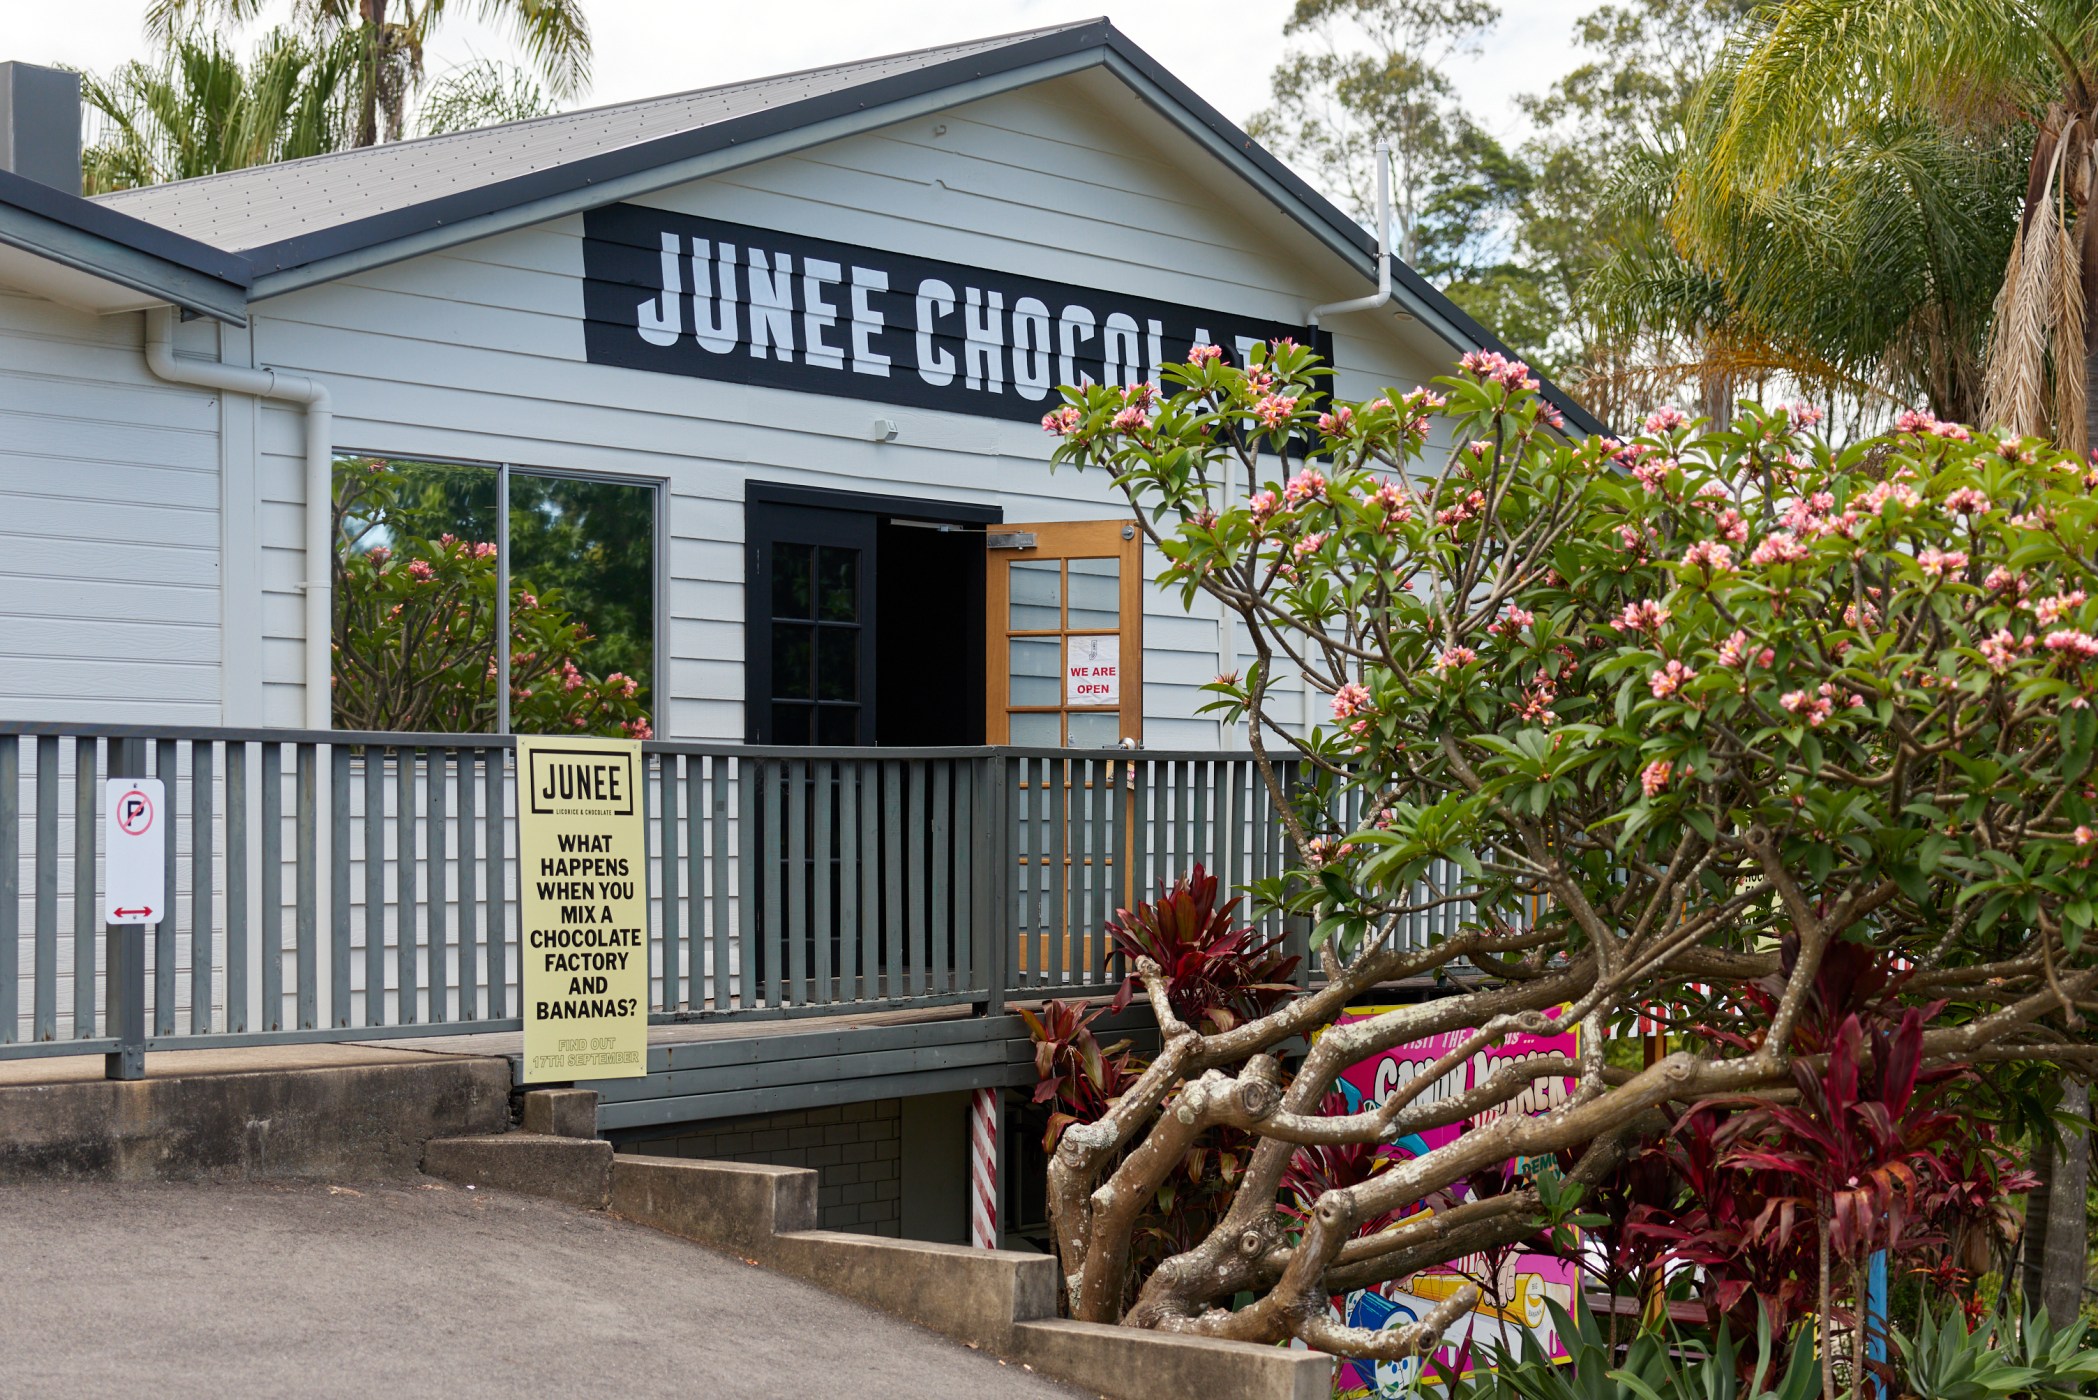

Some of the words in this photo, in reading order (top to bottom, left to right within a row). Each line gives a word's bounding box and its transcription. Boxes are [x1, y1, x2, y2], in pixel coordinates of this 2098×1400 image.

[637, 231, 891, 377] JUNEE
[916, 278, 1301, 438] CHOCOLAT
[1070, 667, 1088, 677] WE
[1092, 667, 1116, 677] ARE
[1077, 685, 1109, 694] OPEN
[542, 763, 622, 801] JUNEE
[584, 809, 612, 817] CHOCOLATE
[557, 834, 613, 853] WHAT
[541, 858, 629, 877] HAPPENS
[536, 882, 595, 900] WHEN
[599, 881, 634, 900] YOU
[561, 905, 596, 924] MIX
[600, 905, 613, 923] A
[530, 928, 642, 949] CHOCOLATE
[545, 952, 629, 972] FACTORY
[568, 976, 608, 995] AND
[536, 998, 638, 1020] BANANAS?
[558, 1039, 588, 1052] FIND
[590, 1037, 616, 1050] OUT
[532, 1055, 565, 1069] 17TH
[567, 1050, 640, 1067] SEPTEMBER
